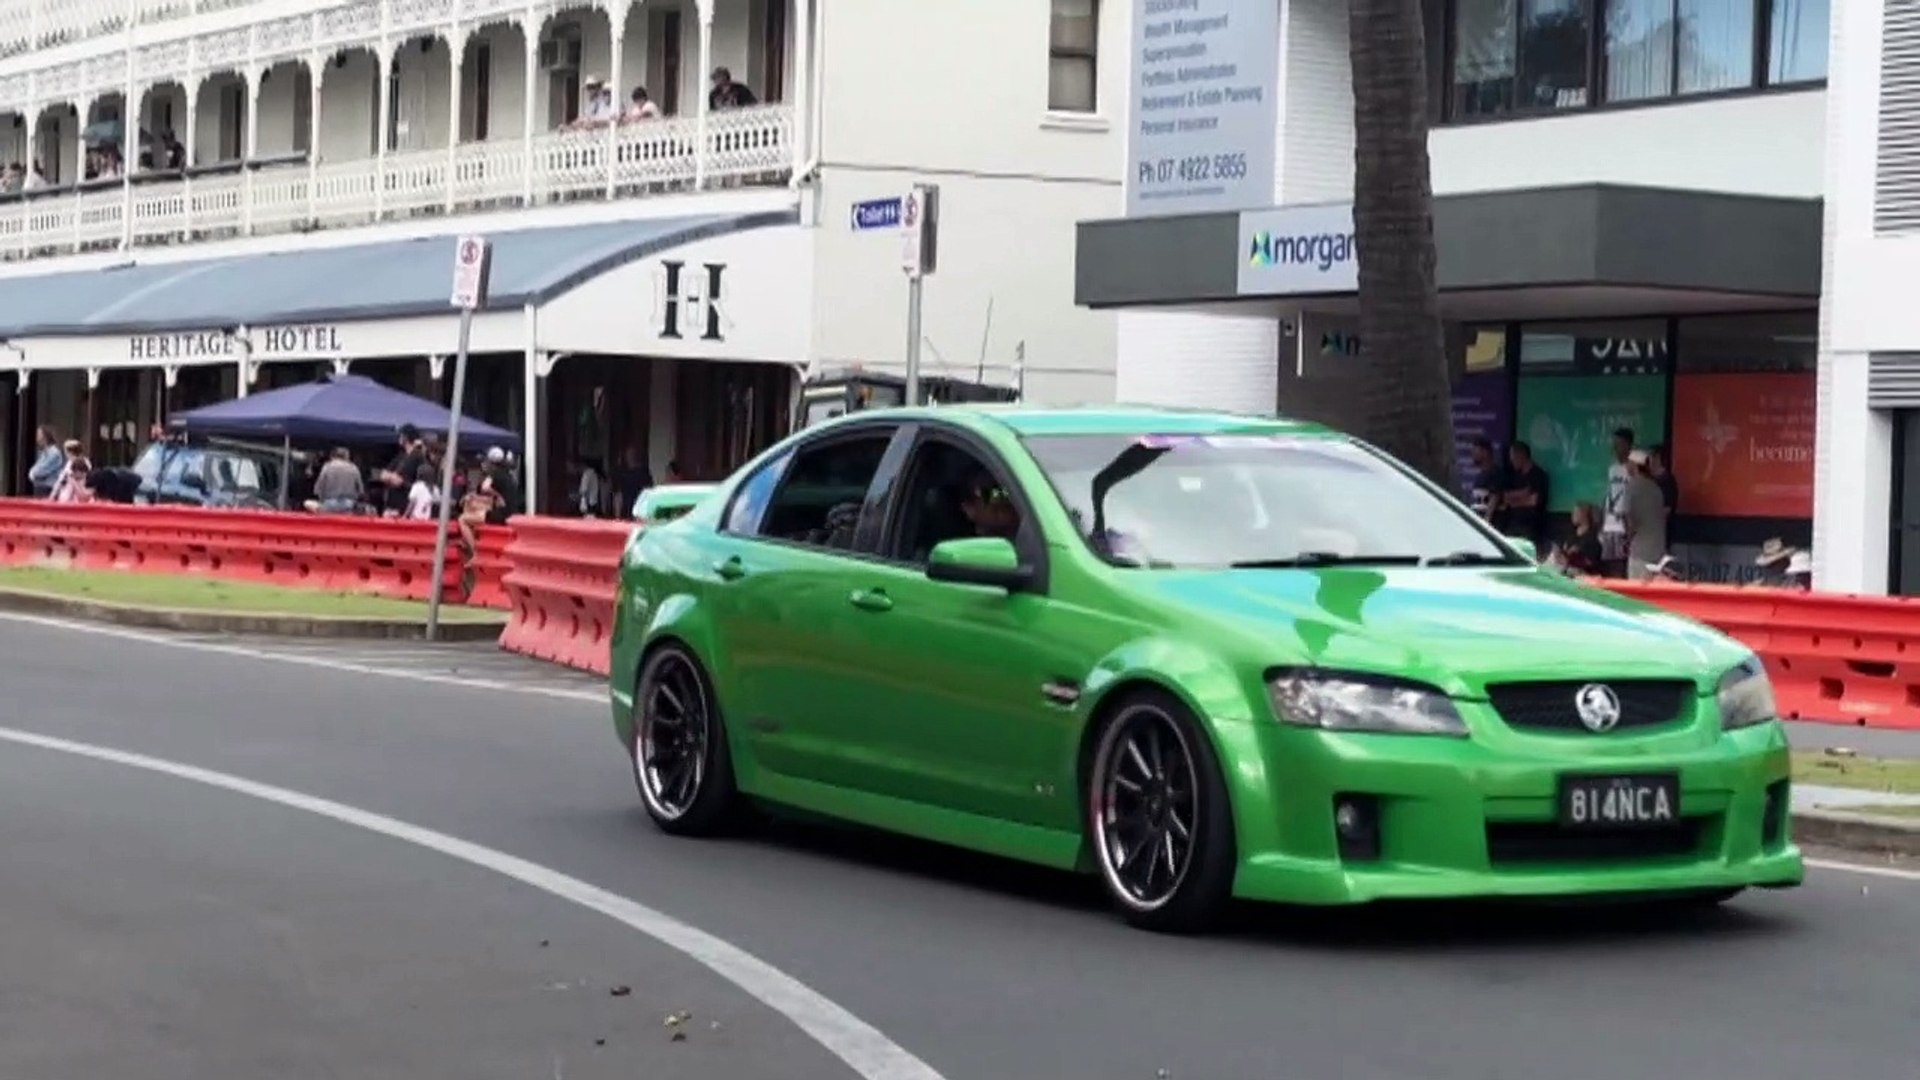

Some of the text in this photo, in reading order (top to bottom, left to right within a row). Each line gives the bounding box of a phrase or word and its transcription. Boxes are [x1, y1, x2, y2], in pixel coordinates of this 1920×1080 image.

[1225, 86, 1263, 104] Planning
[1139, 161, 1155, 183] Ph
[1157, 159, 1174, 183] 07
[1179, 156, 1210, 181] 4922
[130, 325, 342, 360] HERITAGE HOTEL
